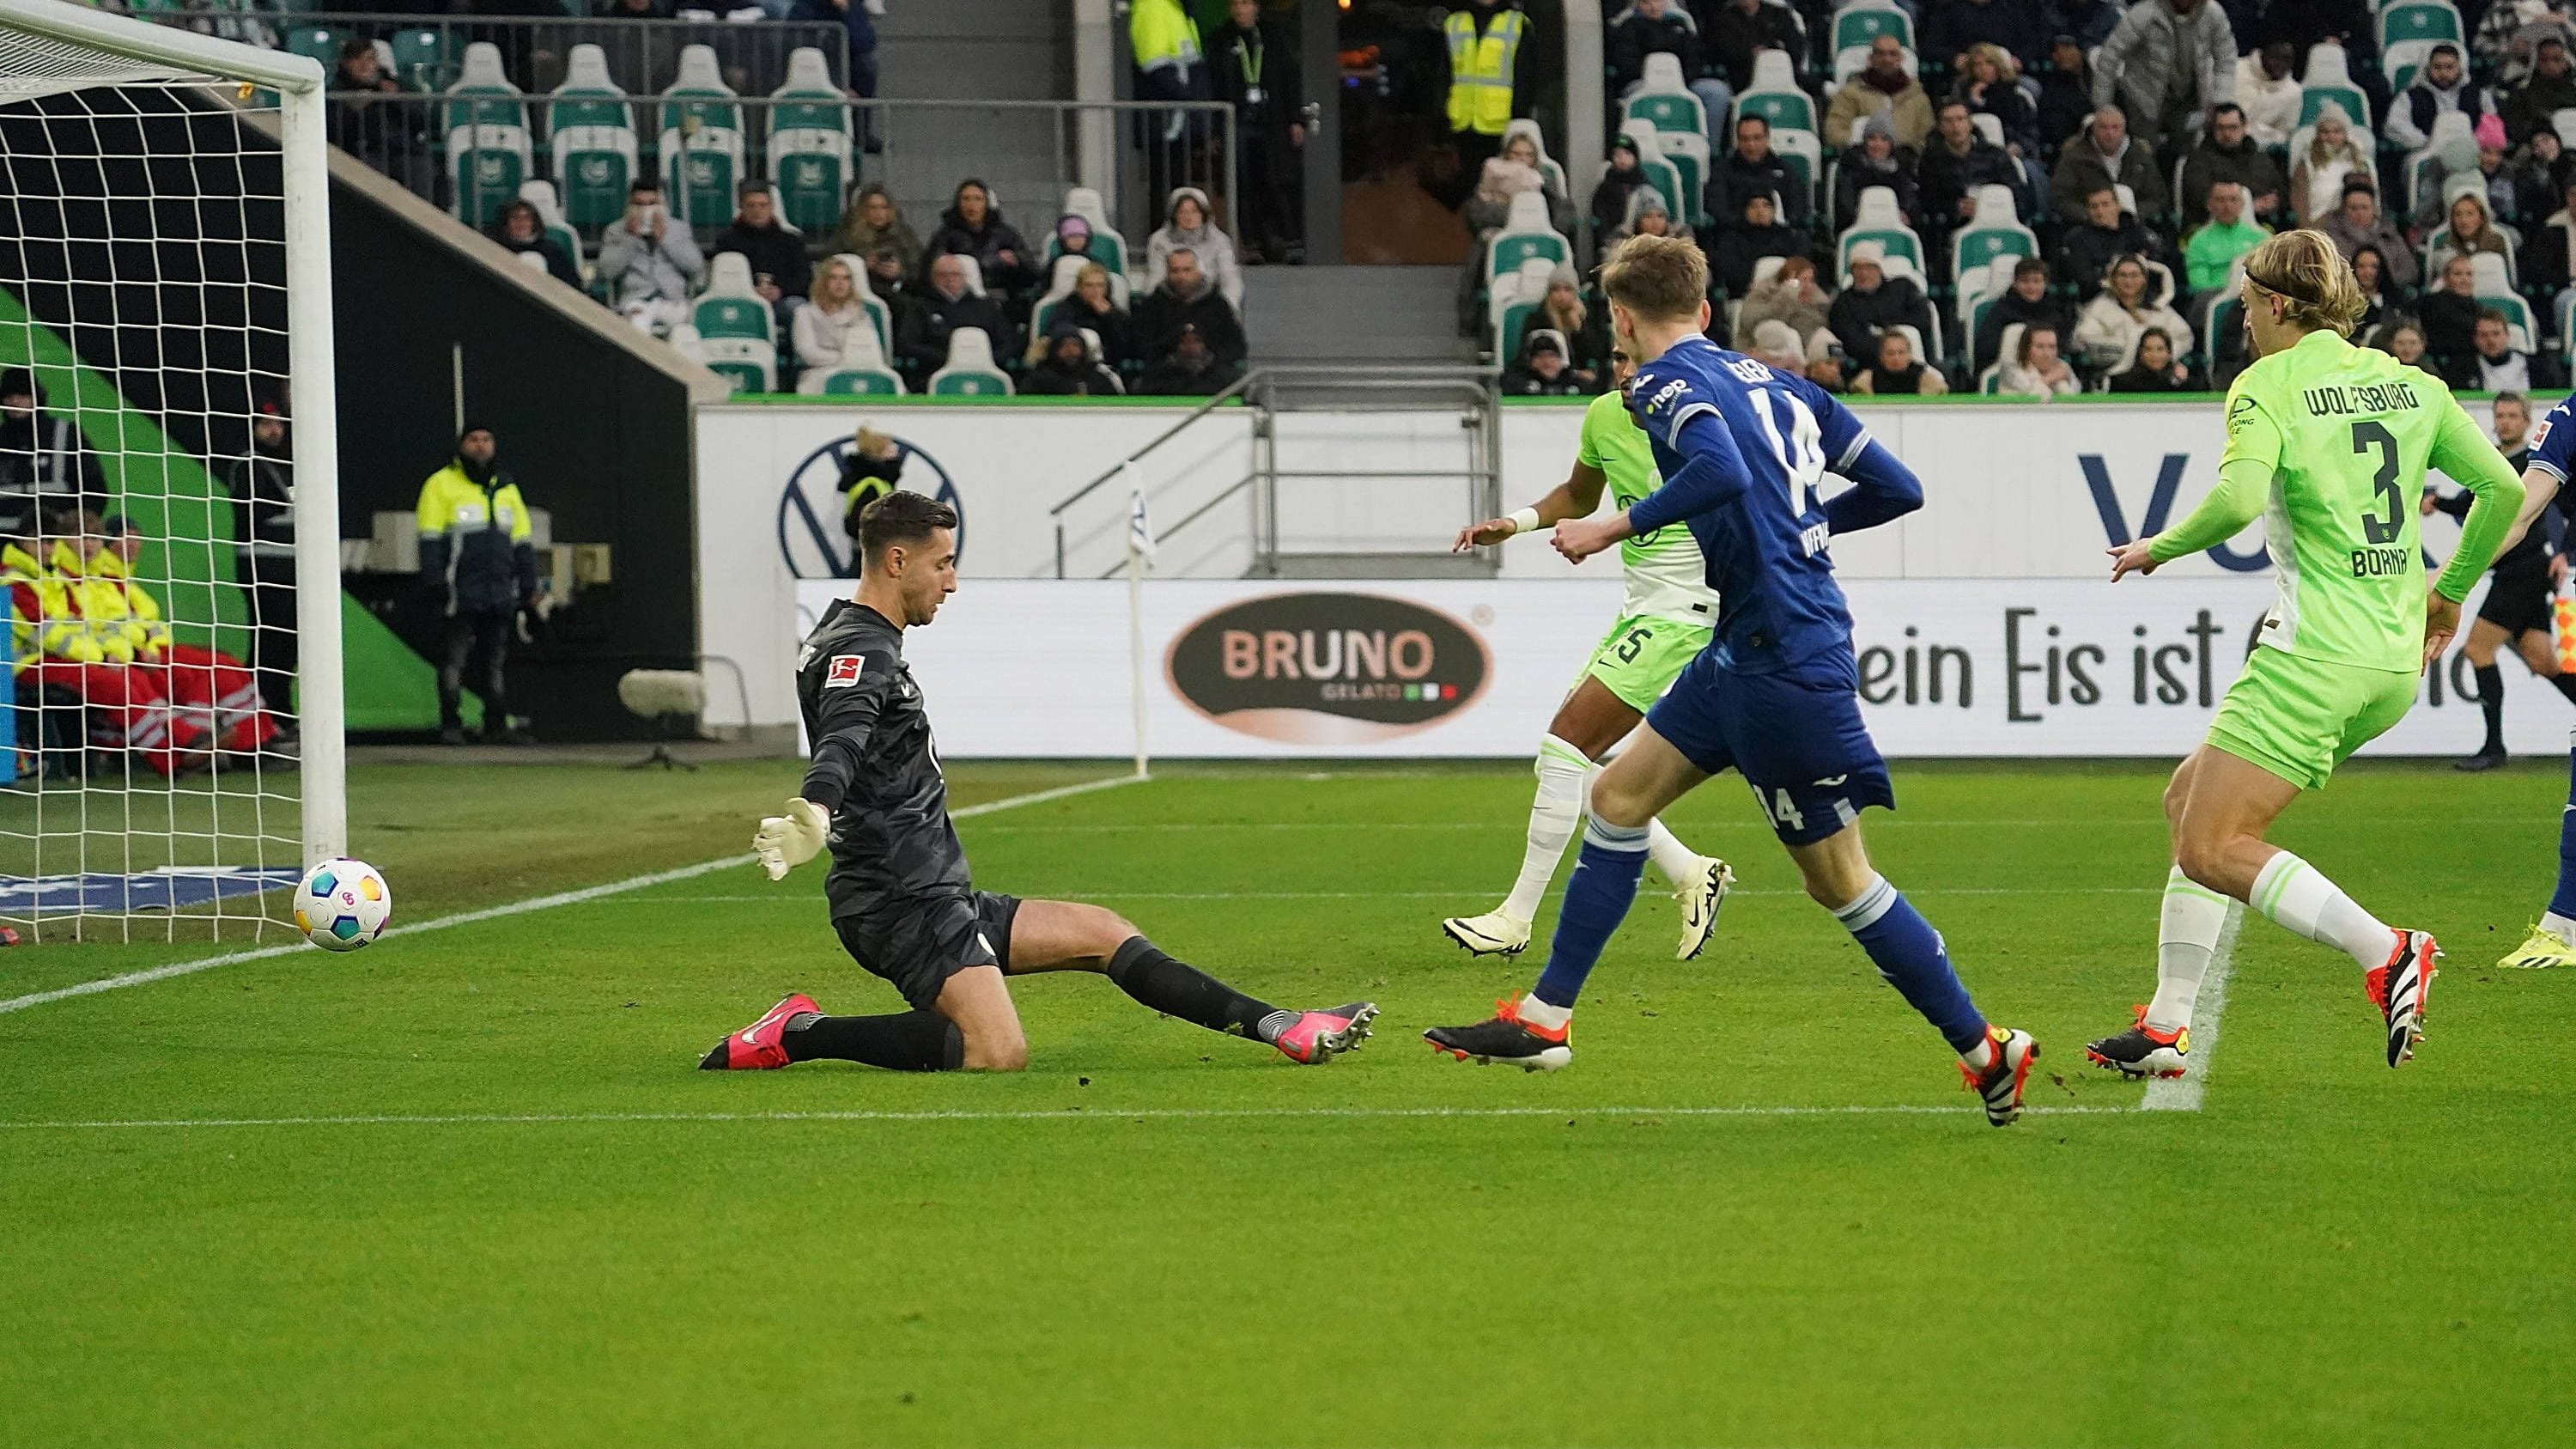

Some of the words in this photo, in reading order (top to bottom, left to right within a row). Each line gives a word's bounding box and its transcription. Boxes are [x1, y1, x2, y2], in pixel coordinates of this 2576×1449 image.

[2302, 383, 2421, 417] WOLFSBURG
[1747, 387, 1827, 519] 14
[2351, 421, 2405, 545] 3
[2351, 547, 2411, 578] BORNA
[1223, 630, 1435, 680] BRUNO
[1609, 626, 1653, 665] 5
[2005, 607, 2105, 722] Eis
[2134, 609, 2223, 707] ist
[1753, 782, 1805, 831] 14
